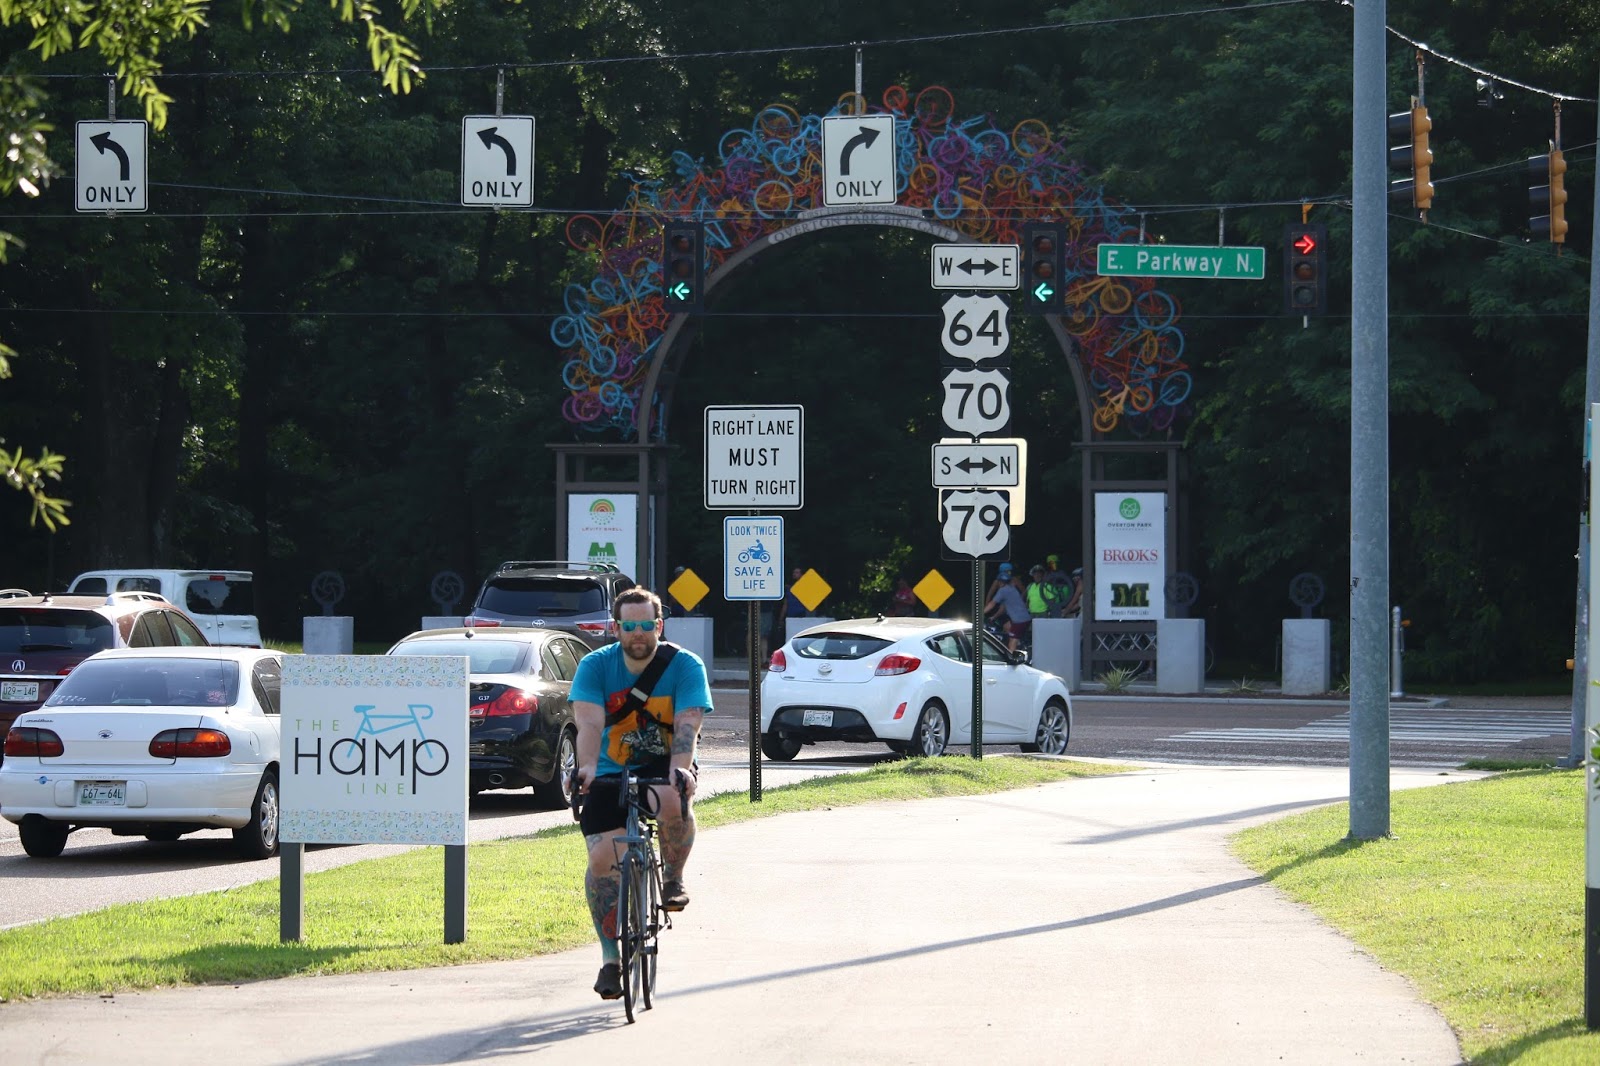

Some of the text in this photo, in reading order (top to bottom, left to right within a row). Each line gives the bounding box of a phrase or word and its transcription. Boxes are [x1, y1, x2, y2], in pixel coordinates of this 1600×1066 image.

[85, 186, 136, 203] ONLY
[472, 181, 523, 198] ONLY
[836, 180, 882, 197] ONLY
[774, 214, 953, 242] OVERTON PARK BIKE GATE
[939, 257, 1012, 276] W E
[1106, 250, 1254, 277] E. Parkway N.
[949, 309, 1002, 347] 64
[949, 382, 1003, 420] 70
[712, 420, 794, 435] RIGHT LANE
[729, 448, 779, 466] MUST
[941, 456, 1011, 475] S N
[711, 479, 796, 495] TURN RIGHT
[730, 525, 777, 536] LOOK TWICE
[951, 504, 1002, 542] 79
[1103, 549, 1158, 562] BROOKS
[734, 566, 774, 577] SAVE A
[743, 579, 766, 590] LIFE
[3, 686, 37, 696] U29-14P
[295, 719, 340, 731] THE
[82, 788, 123, 799] C67-64L
[346, 782, 404, 795] LINE
